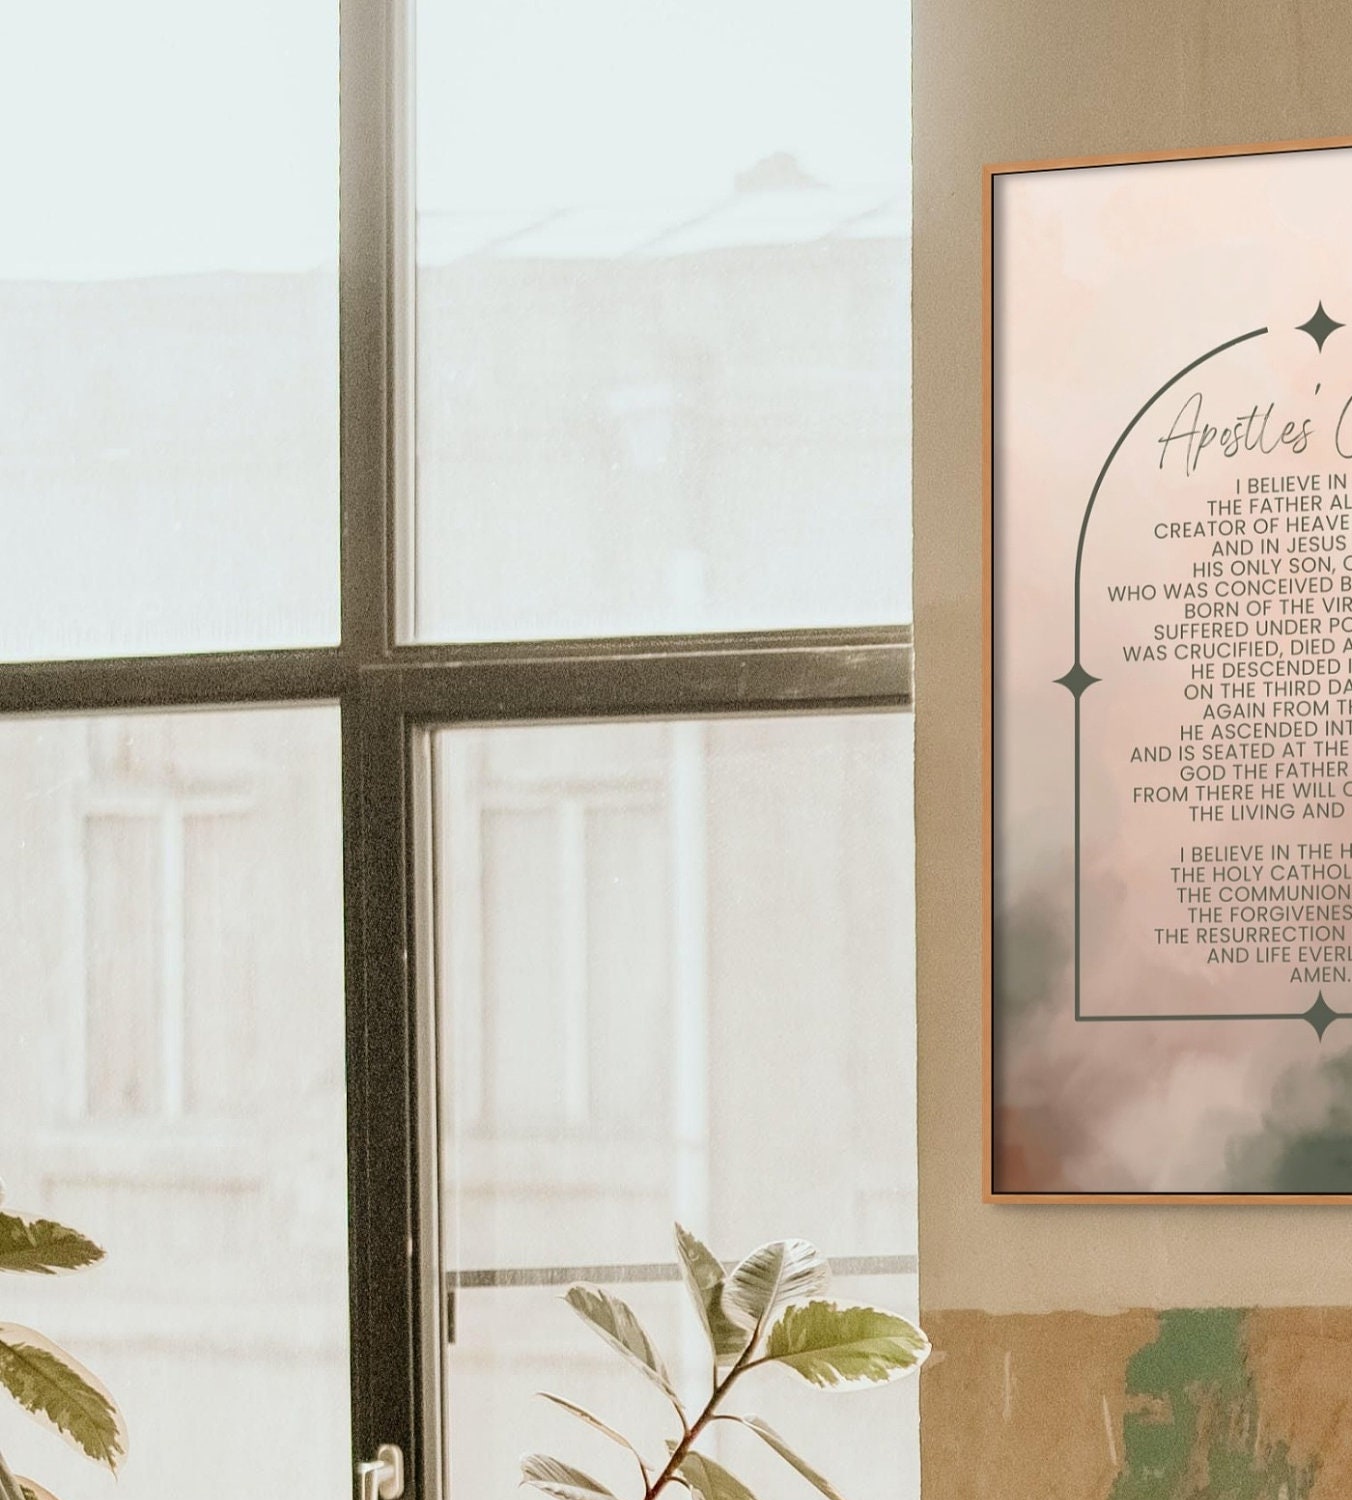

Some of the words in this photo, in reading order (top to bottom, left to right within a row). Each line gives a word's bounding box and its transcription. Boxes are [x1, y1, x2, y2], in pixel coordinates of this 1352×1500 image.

[1158, 383, 1321, 477] Apostles'
[1236, 479, 1241, 495] I
[1247, 475, 1321, 494] BELIEVE
[1328, 473, 1347, 490] IN
[1206, 499, 1243, 516] THE
[1249, 495, 1323, 514] FATHER
[1153, 519, 1247, 539] CREATOR
[1252, 517, 1280, 534] OF
[1211, 539, 1254, 557] AND
[1260, 538, 1280, 555] IN
[1286, 534, 1348, 554] JESUS
[1192, 561, 1224, 578] HIS
[1230, 558, 1283, 576] ONLY
[1288, 556, 1337, 575] SON,
[1106, 585, 1157, 602] WHO
[1162, 582, 1209, 600] WAS
[1214, 577, 1334, 597] CONCEIVED
[1184, 601, 1240, 619] BORN
[1245, 599, 1273, 616] OF
[1278, 598, 1315, 616] THE
[1153, 621, 1250, 641] SUFFERED
[1255, 618, 1322, 636] UNDER
[1122, 645, 1168, 662] WAS
[1173, 640, 1284, 660] CRUCIFIED,
[1290, 638, 1336, 656] DIED
[1191, 663, 1216, 680] HE
[1221, 658, 1342, 679] DESCENDED
[1183, 683, 1214, 700] ON
[1220, 682, 1256, 699] THE
[1262, 680, 1322, 698] THIRD
[1202, 702, 1266, 720] AGAIN
[1272, 700, 1330, 718] FROM
[1180, 725, 1204, 741] HE
[1210, 721, 1319, 740] ASCENDED
[1129, 746, 1173, 763] AND
[1178, 745, 1196, 761] IS
[1201, 742, 1276, 760] SEATED
[1281, 741, 1307, 758] AT
[1312, 740, 1350, 757] THE
[1179, 765, 1227, 782] GOD
[1232, 763, 1268, 780] THE
[1275, 761, 1349, 779] FATHER
[1133, 786, 1189, 803] FROM
[1194, 784, 1255, 801] THERE
[1261, 783, 1286, 800] HE
[1292, 782, 1337, 798] WILL
[1188, 805, 1225, 822] THE
[1231, 803, 1296, 821] LIVING
[1302, 802, 1346, 819] AND
[1180, 847, 1184, 863] I
[1191, 845, 1264, 863] BELIEVE
[1271, 844, 1290, 861] IN
[1297, 843, 1333, 860] THE
[1170, 867, 1206, 883] THE
[1212, 865, 1264, 882] HOLY
[1176, 887, 1212, 903] THE
[1218, 884, 1351, 902] COMMUNION
[1187, 907, 1223, 923] THE
[1153, 928, 1190, 944] THE
[1196, 925, 1346, 944] RESURRECTION
[1206, 947, 1250, 964] AND
[1256, 947, 1291, 963] LIFE
[1289, 966, 1352, 983] AMEN.
